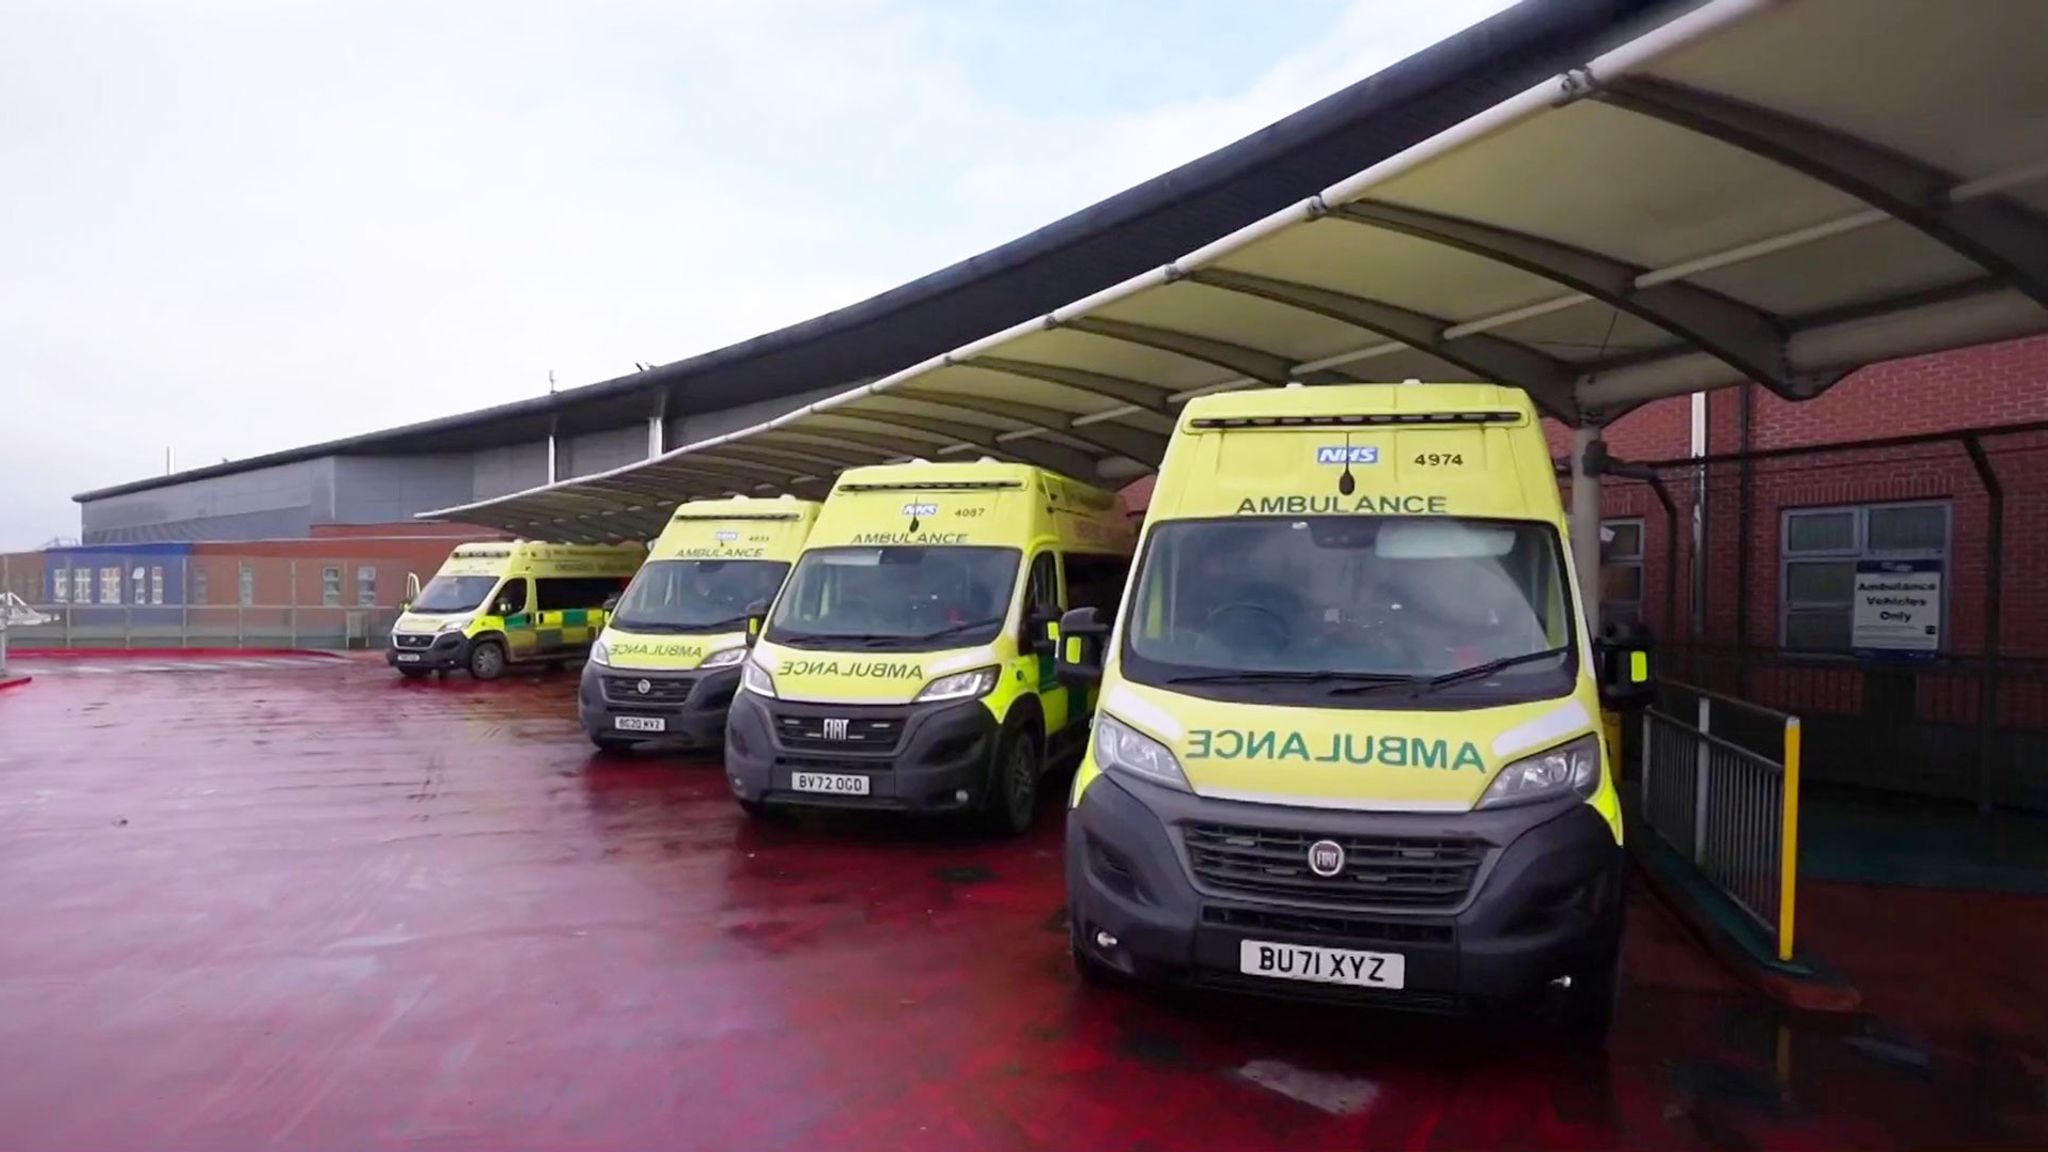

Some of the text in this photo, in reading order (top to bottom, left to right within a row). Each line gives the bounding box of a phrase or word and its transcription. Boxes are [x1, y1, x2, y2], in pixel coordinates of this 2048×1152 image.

[1319, 448, 1376, 463] NHS
[1414, 453, 1464, 466] 4974
[903, 504, 938, 515] NHS
[1236, 496, 1448, 513] AMBULANCE
[850, 532, 969, 544] AMBULANCE
[674, 548, 764, 558] AMBULANCE
[1880, 611, 1912, 623] Only
[823, 718, 850, 740] FIAT
[799, 775, 832, 790] BV72
[1315, 849, 1337, 868] FIAT
[1259, 946, 1385, 982] BU71 XYZ
